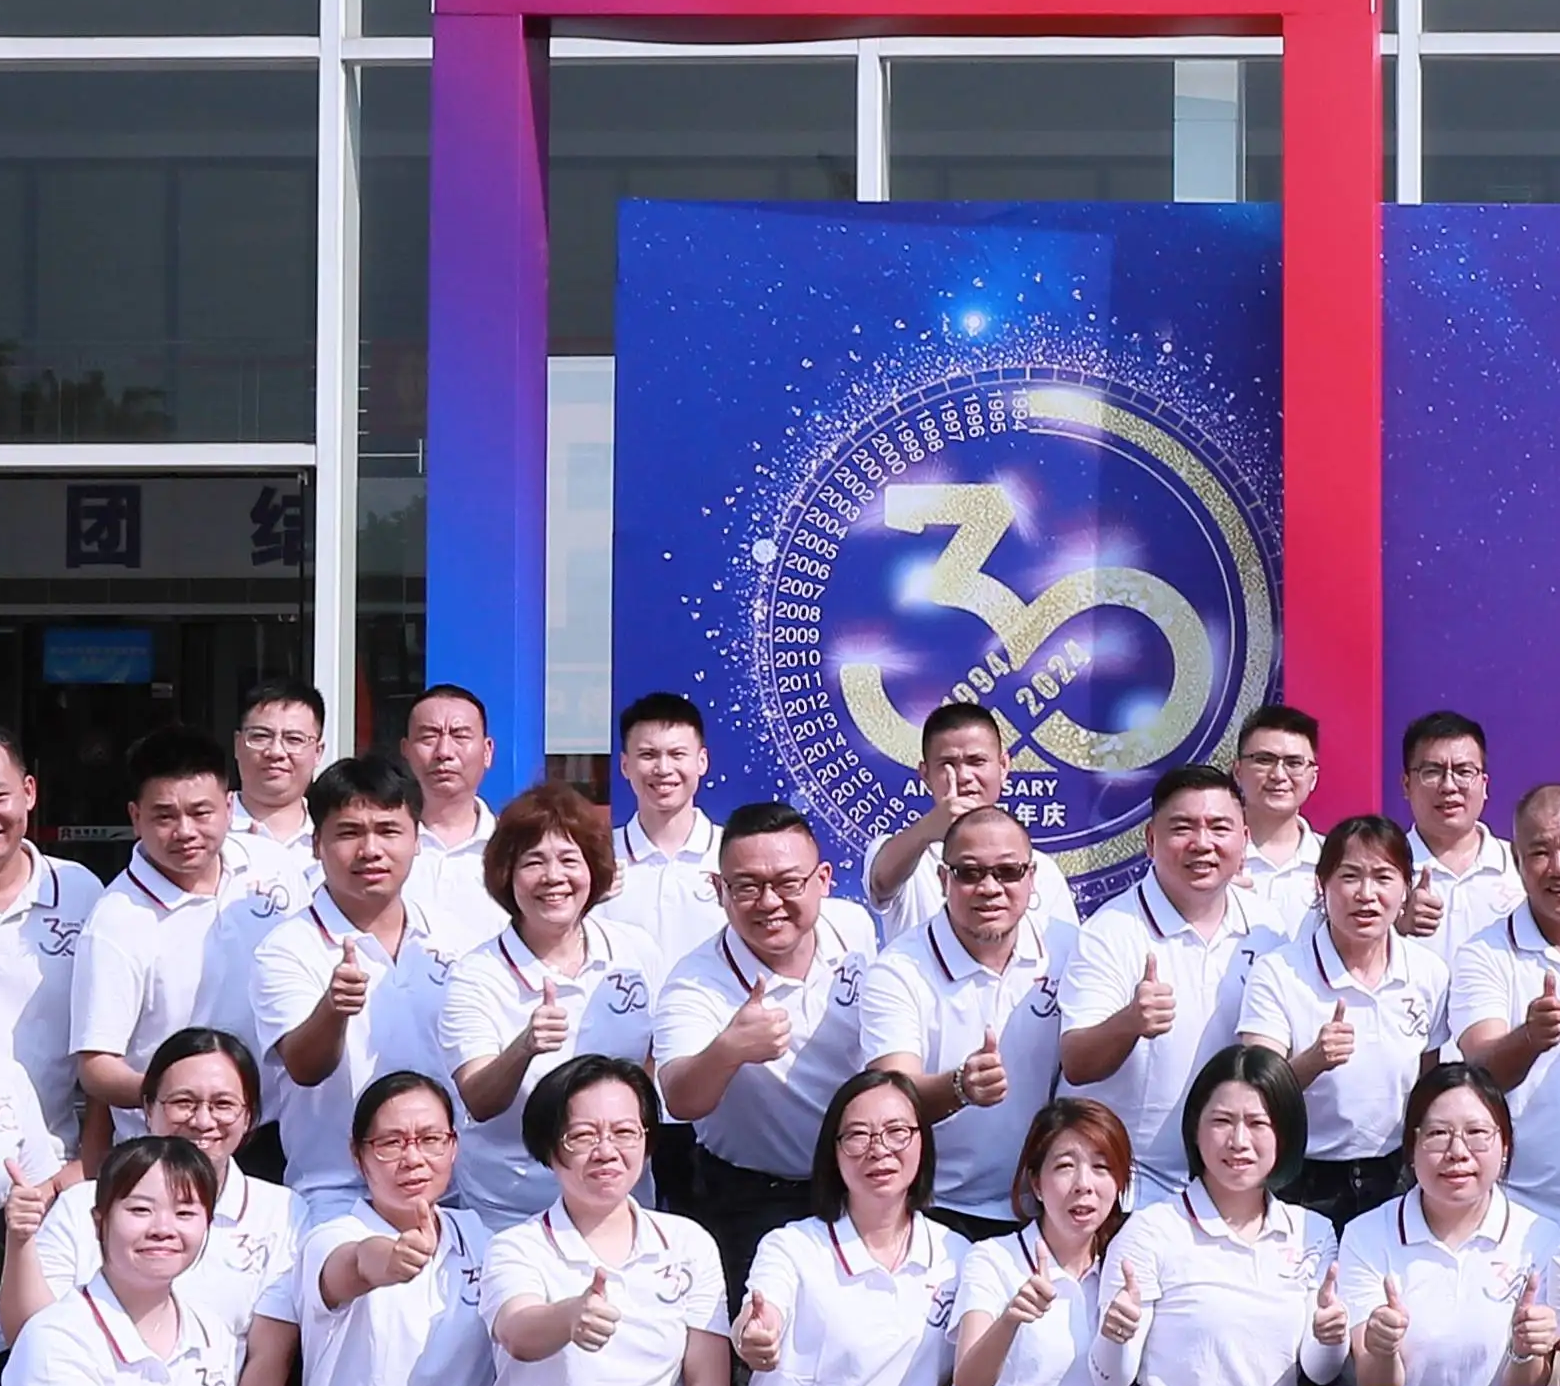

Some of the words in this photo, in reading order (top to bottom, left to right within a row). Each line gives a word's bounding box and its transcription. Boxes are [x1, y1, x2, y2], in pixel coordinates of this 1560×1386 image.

[939, 400, 966, 443] 1997
[963, 393, 986, 439] 1996
[987, 388, 1008, 434] 1995
[895, 421, 925, 464] 1999
[916, 409, 945, 454] 1998
[851, 448, 889, 490] 2001
[871, 432, 907, 476] 2000
[818, 485, 861, 522] 2003
[834, 465, 875, 505] 2002
[804, 505, 849, 541] 2004
[793, 528, 838, 560] 2005
[785, 552, 832, 581] 2006
[778, 576, 826, 601] 2007
[775, 601, 822, 623] 2008
[774, 626, 820, 645] 2009
[775, 650, 821, 669] 2010
[939, 650, 1011, 707] 994
[1015, 637, 1092, 718] 2024
[779, 671, 823, 693] 2011
[784, 692, 830, 718] 2012
[792, 712, 838, 742] 2013
[802, 733, 848, 766] 2014
[816, 749, 860, 787] 2015
[831, 766, 874, 805] 2016
[848, 782, 887, 824] 2017
